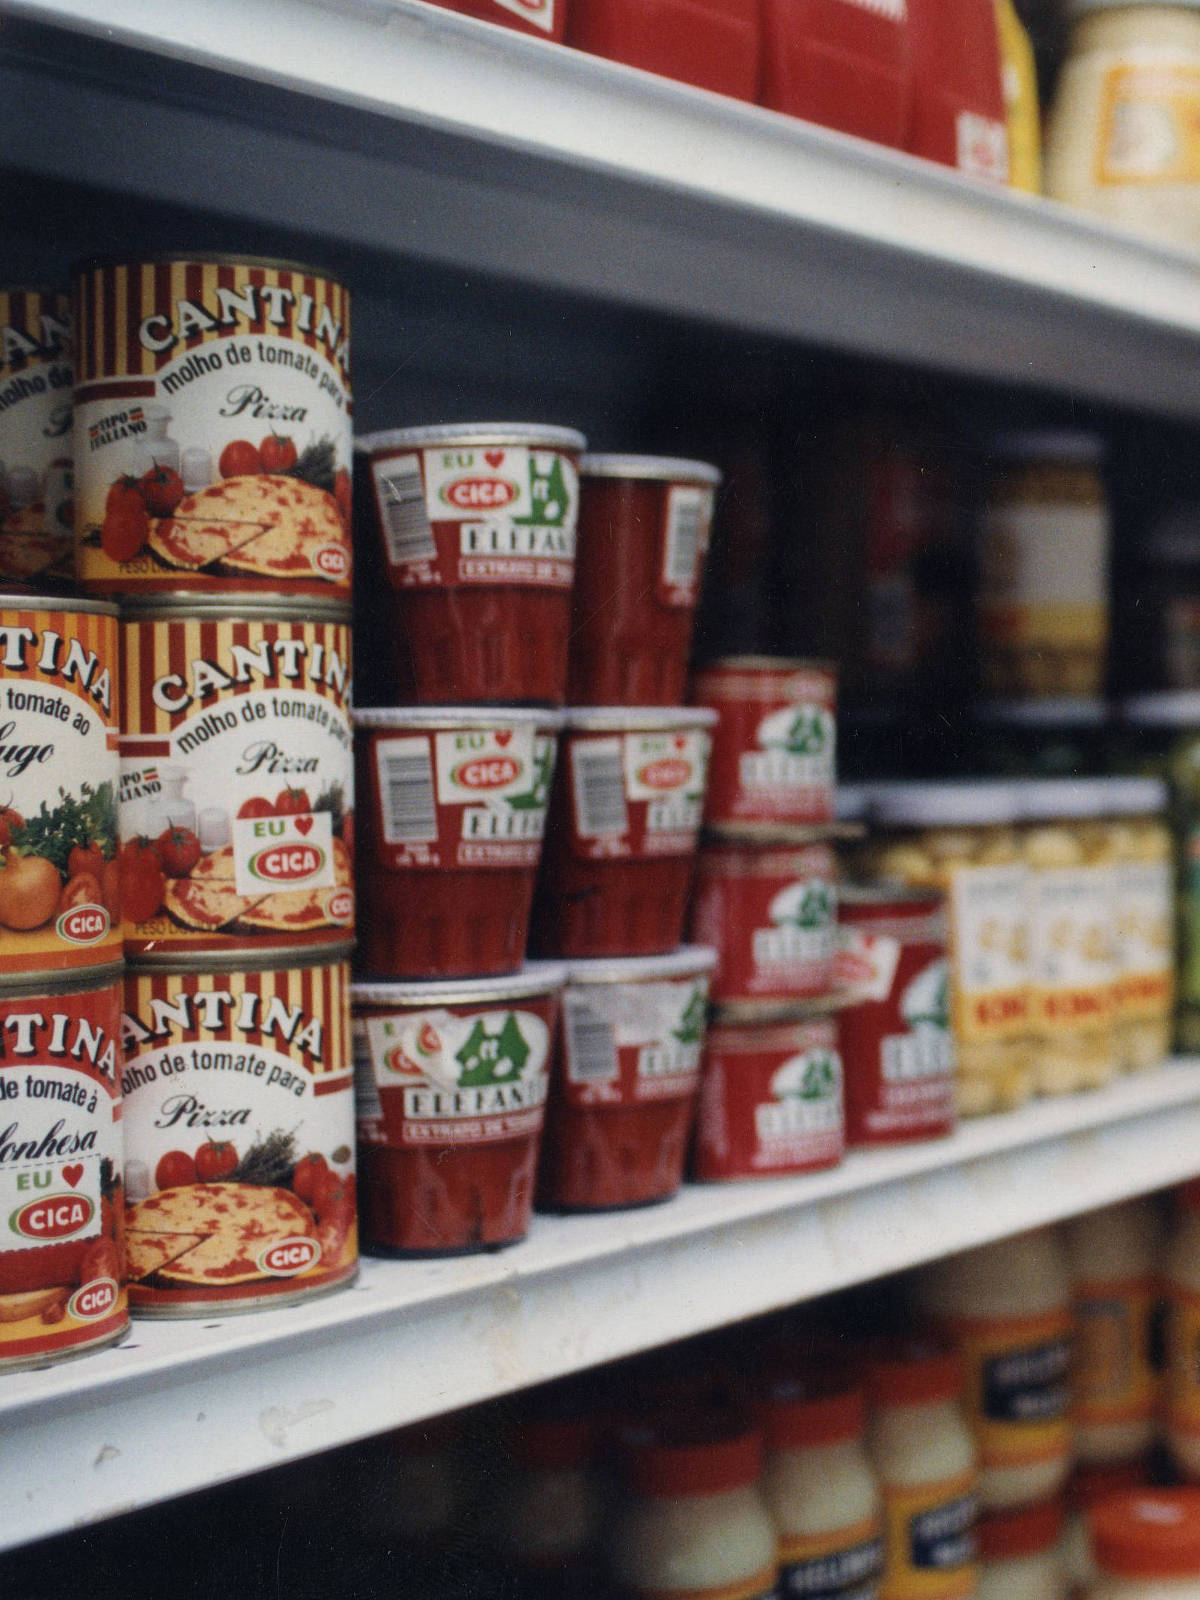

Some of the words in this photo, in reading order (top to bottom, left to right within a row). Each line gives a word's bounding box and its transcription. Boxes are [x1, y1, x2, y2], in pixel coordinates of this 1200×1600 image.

[161, 347, 223, 394] molho
[227, 342, 251, 366] de
[259, 341, 319, 379] tomate
[219, 384, 308, 424] Pizza
[97, 411, 129, 430] TIPO
[443, 454, 474, 468] EU
[453, 483, 510, 504] CICA
[6, 687, 70, 722] tomate
[72, 713, 91, 736] ao
[176, 711, 238, 754] molho
[242, 699, 267, 722] de
[273, 696, 329, 726] tomate
[455, 734, 486, 750] EU
[236, 740, 320, 777] Pizza
[464, 762, 515, 786] CICA
[253, 821, 286, 838] EU
[265, 849, 316, 875] CICA
[69, 912, 103, 934] CICA
[5, 1013, 117, 1080] TINA
[121, 1064, 157, 1097] olho
[160, 1053, 186, 1076] de
[191, 1049, 266, 1074] tomate
[268, 1061, 307, 1097] para
[26, 1074, 88, 1107] tomate
[155, 1094, 253, 1129] Pizza
[16, 1170, 52, 1191] EU
[29, 1204, 84, 1230] CICA
[270, 1245, 311, 1267] CICA
[80, 1287, 112, 1311] CICA
